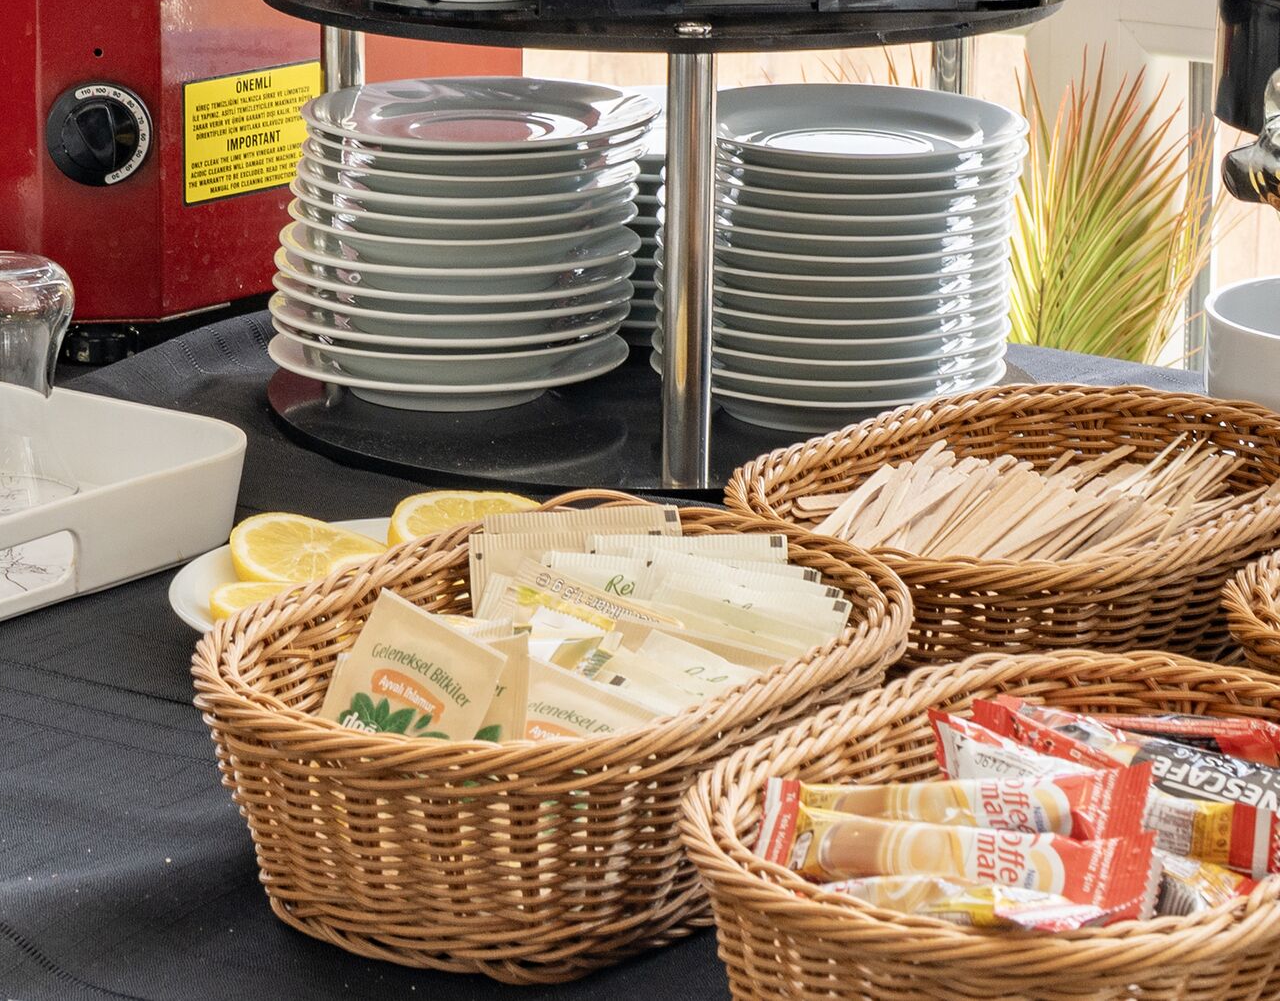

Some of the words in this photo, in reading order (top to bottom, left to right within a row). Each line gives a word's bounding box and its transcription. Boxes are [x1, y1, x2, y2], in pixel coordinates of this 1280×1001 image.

[80, 88, 91, 96] 110
[236, 72, 272, 93] ÖNEMLİ
[137, 116, 145, 125] 70
[225, 118, 231, 126] VE
[140, 133, 147, 142] 60
[227, 129, 281, 152] IMPORTANT
[125, 164, 134, 172] 40
[191, 161, 203, 170] ONLY
[204, 158, 219, 168] CLEAN
[220, 156, 229, 164] THE
[231, 154, 242, 162] LIME
[256, 147, 275, 157] VINEGAR
[277, 145, 286, 153] AND
[191, 169, 207, 179] ACIDIC
[208, 165, 232, 176] CLEANERS
[234, 162, 244, 170] WILL
[246, 158, 264, 168] DAMAGE
[199, 175, 224, 186] WARRANTY
[266, 165, 278, 173] READ
[210, 184, 229, 194] MANUAL
[231, 181, 240, 190] FOR
[241, 177, 264, 188] CLEANING
[371, 643, 434, 677] Geleneksel
[429, 667, 472, 708] Bitkiler
[528, 700, 598, 733] eleneksel
